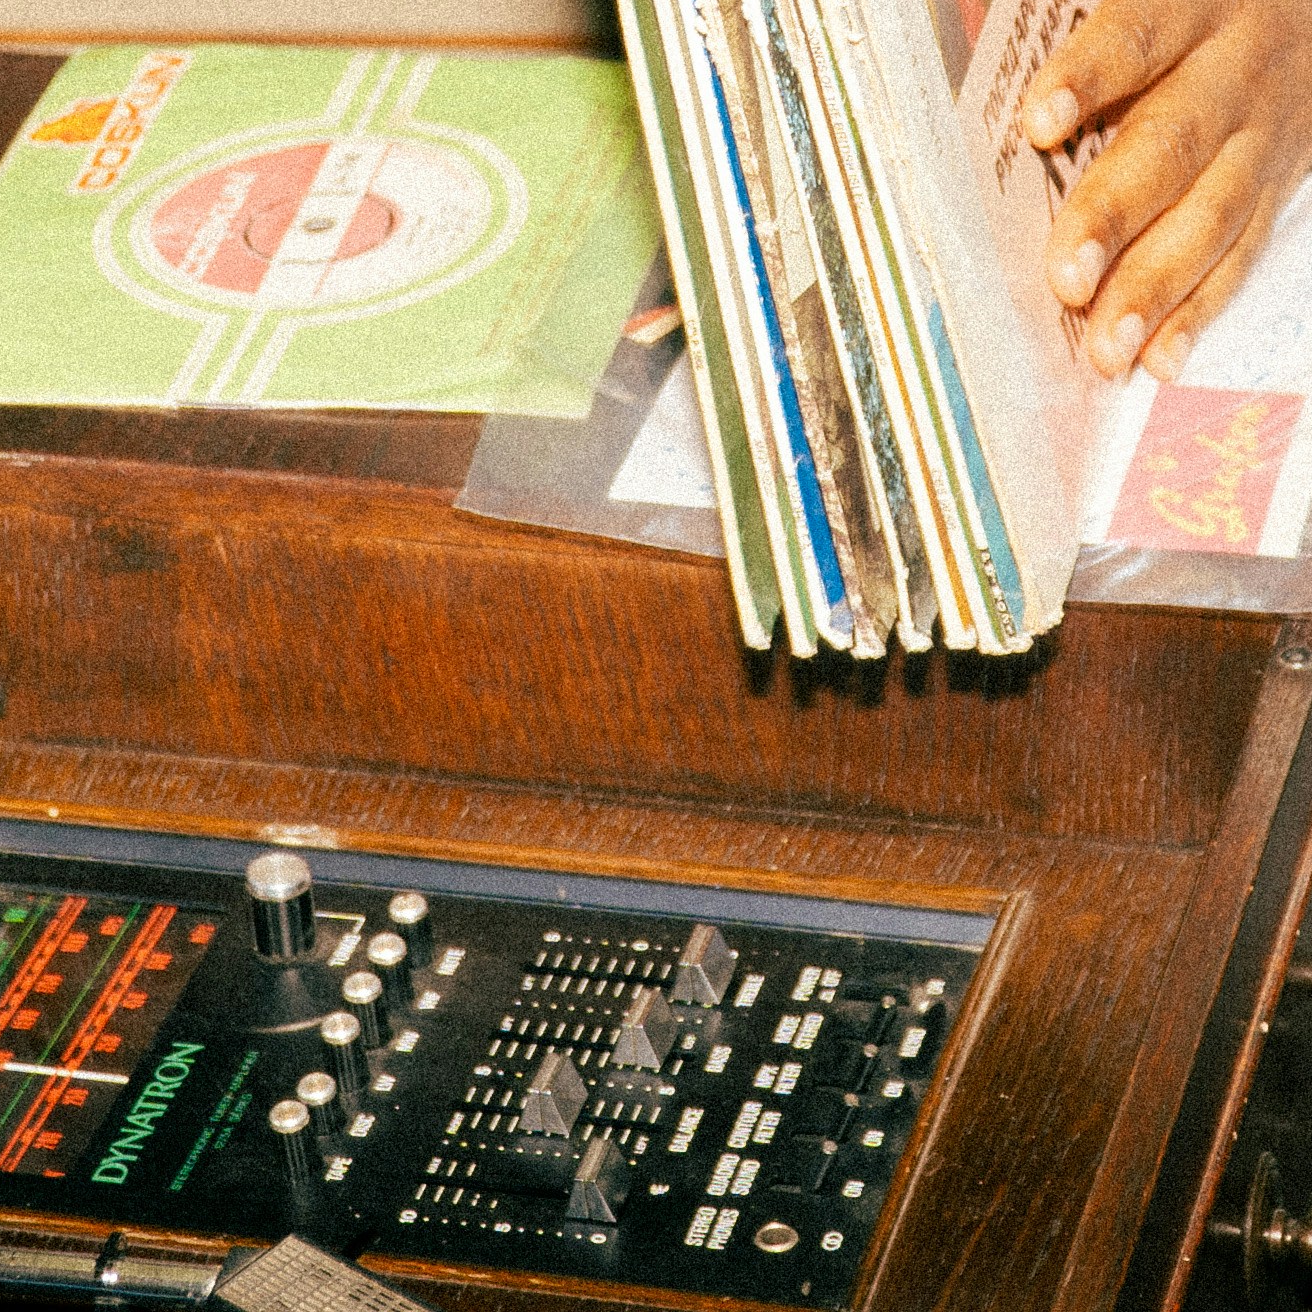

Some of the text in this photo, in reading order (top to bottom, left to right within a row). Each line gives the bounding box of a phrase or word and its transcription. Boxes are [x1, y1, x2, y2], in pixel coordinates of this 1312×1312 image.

[91, 1040, 207, 1185] DYNATRON
[668, 1107, 705, 1153] BALANCE
[727, 1100, 763, 1149] CONTOUR
[751, 1110, 783, 1144] FILTER
[324, 1156, 353, 1182] TAPE
[706, 1153, 741, 1197] QUADRO
[730, 1158, 761, 1196] SOUND
[683, 1205, 718, 1247] STEREO
[705, 1207, 740, 1250] PHONES
